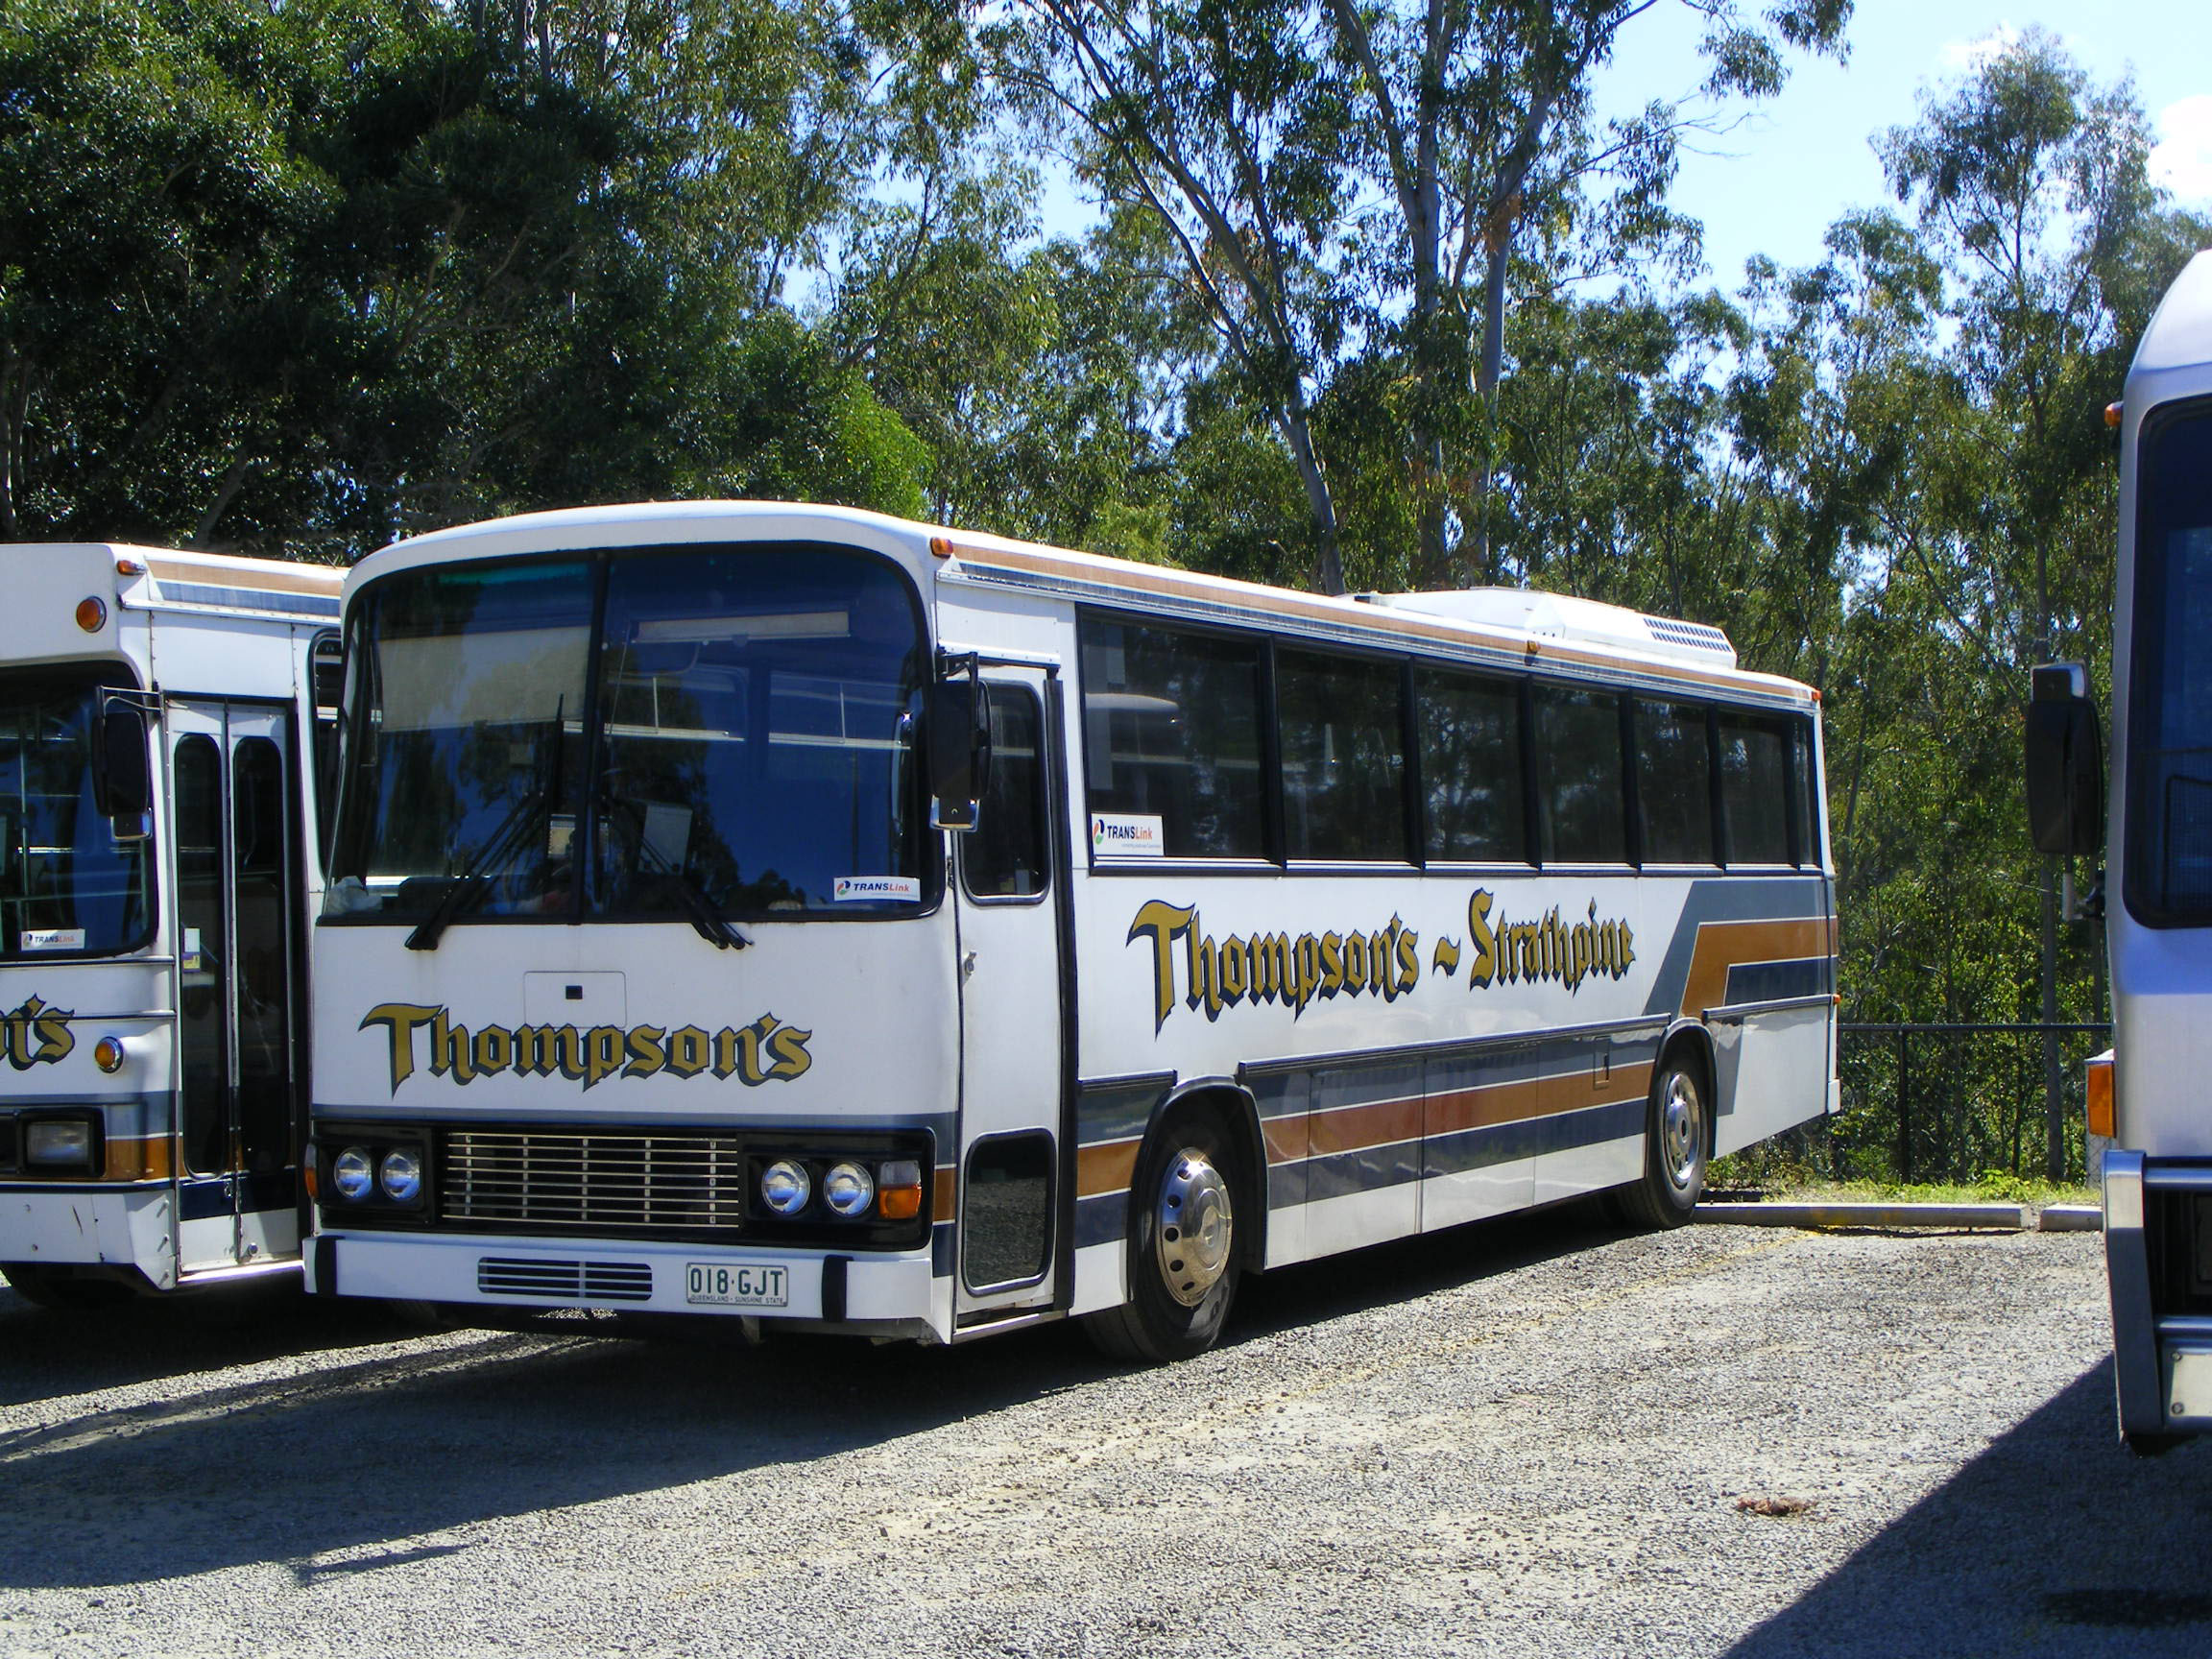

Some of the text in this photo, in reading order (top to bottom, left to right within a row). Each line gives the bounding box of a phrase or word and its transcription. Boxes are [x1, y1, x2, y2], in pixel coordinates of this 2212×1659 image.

[1107, 825, 1153, 840] TRANSLink
[854, 882, 910, 893] TRANSLink
[1126, 899, 1419, 1042] Thompson's
[1469, 886, 1636, 998] Strathpine
[357, 1002, 812, 1101] Thompson's
